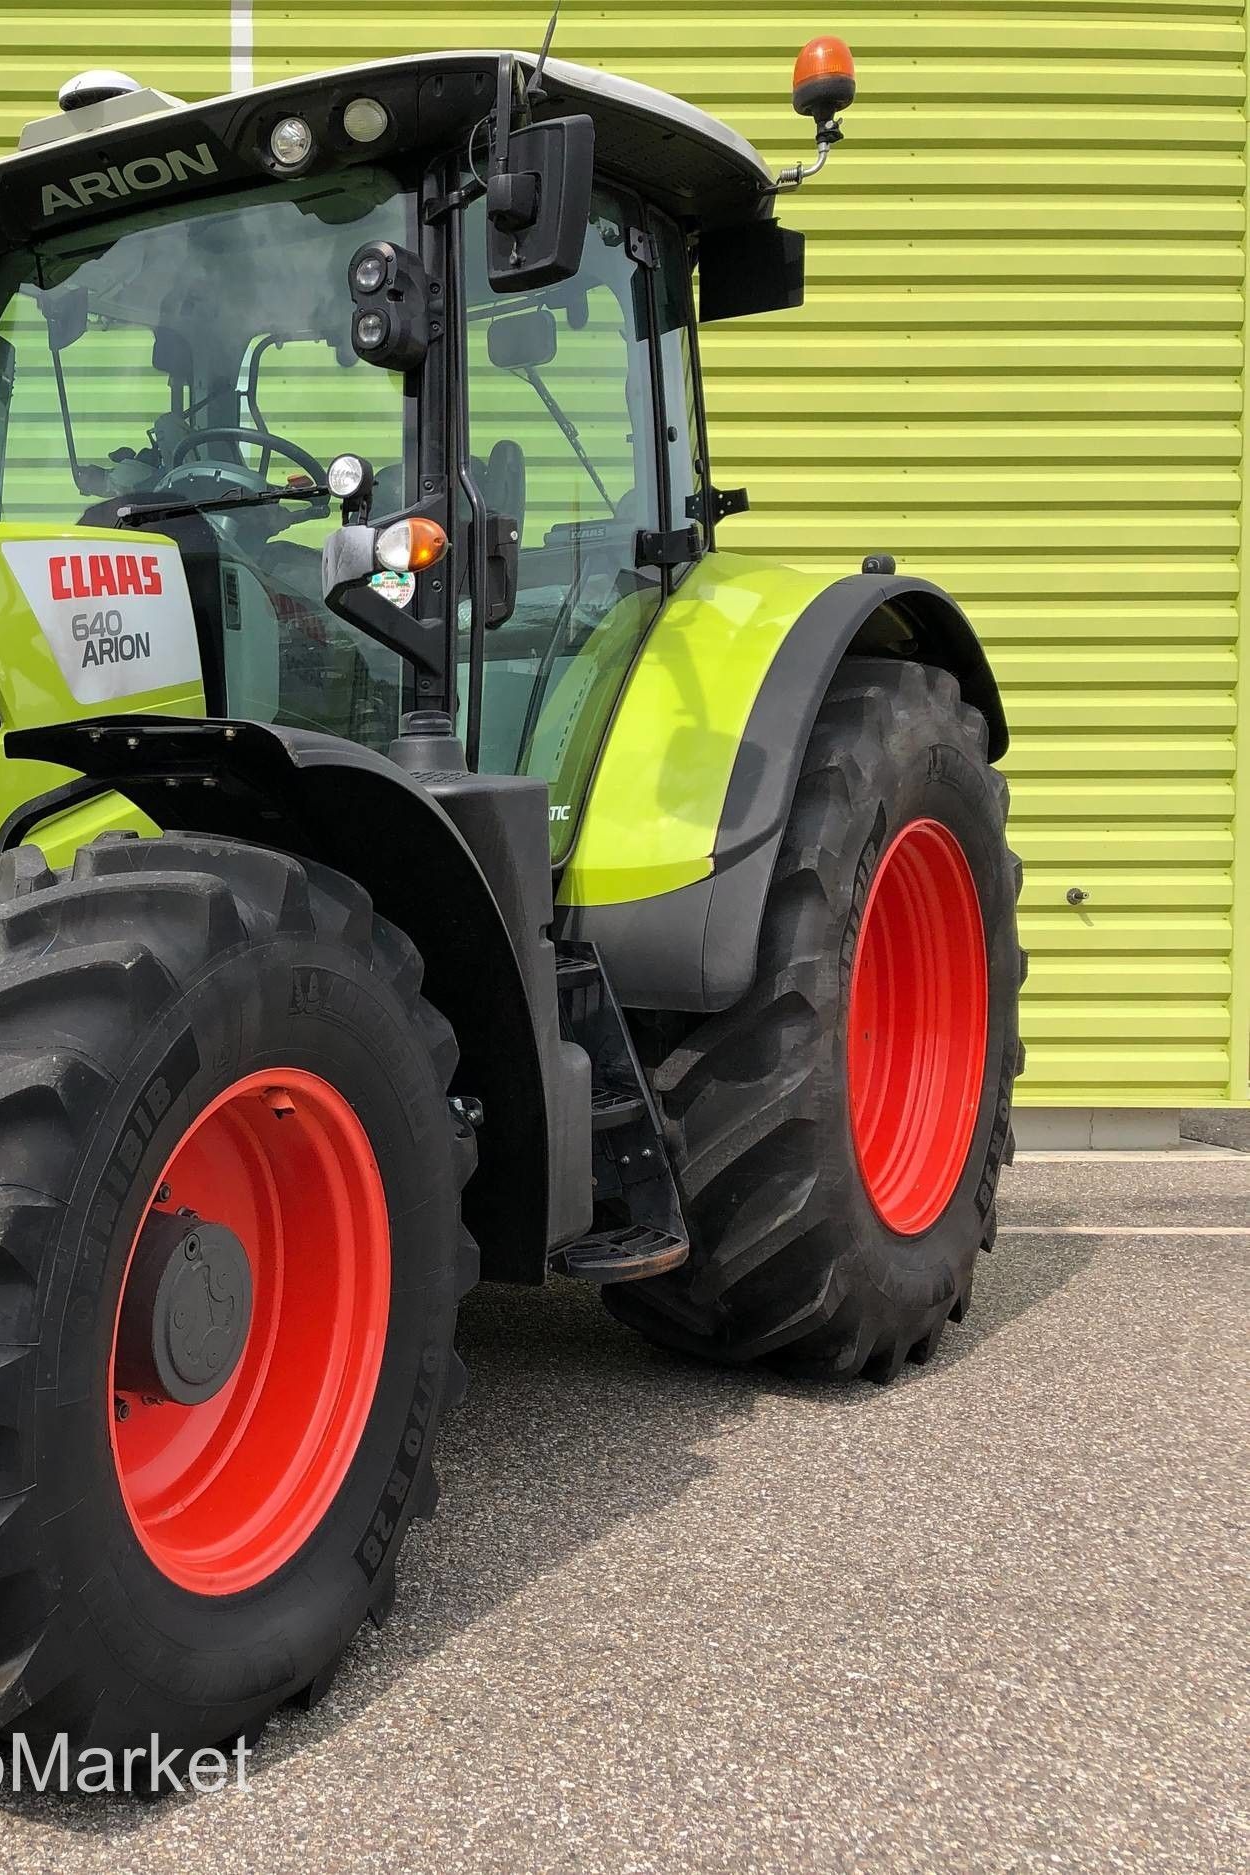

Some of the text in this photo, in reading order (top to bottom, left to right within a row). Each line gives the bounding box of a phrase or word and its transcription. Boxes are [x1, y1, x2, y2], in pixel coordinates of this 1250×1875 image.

[42, 143, 219, 216] ARION
[48, 554, 163, 601] CLAAS
[71, 609, 123, 642] 640
[81, 631, 151, 669] ARION
[549, 805, 571, 821] TIC
